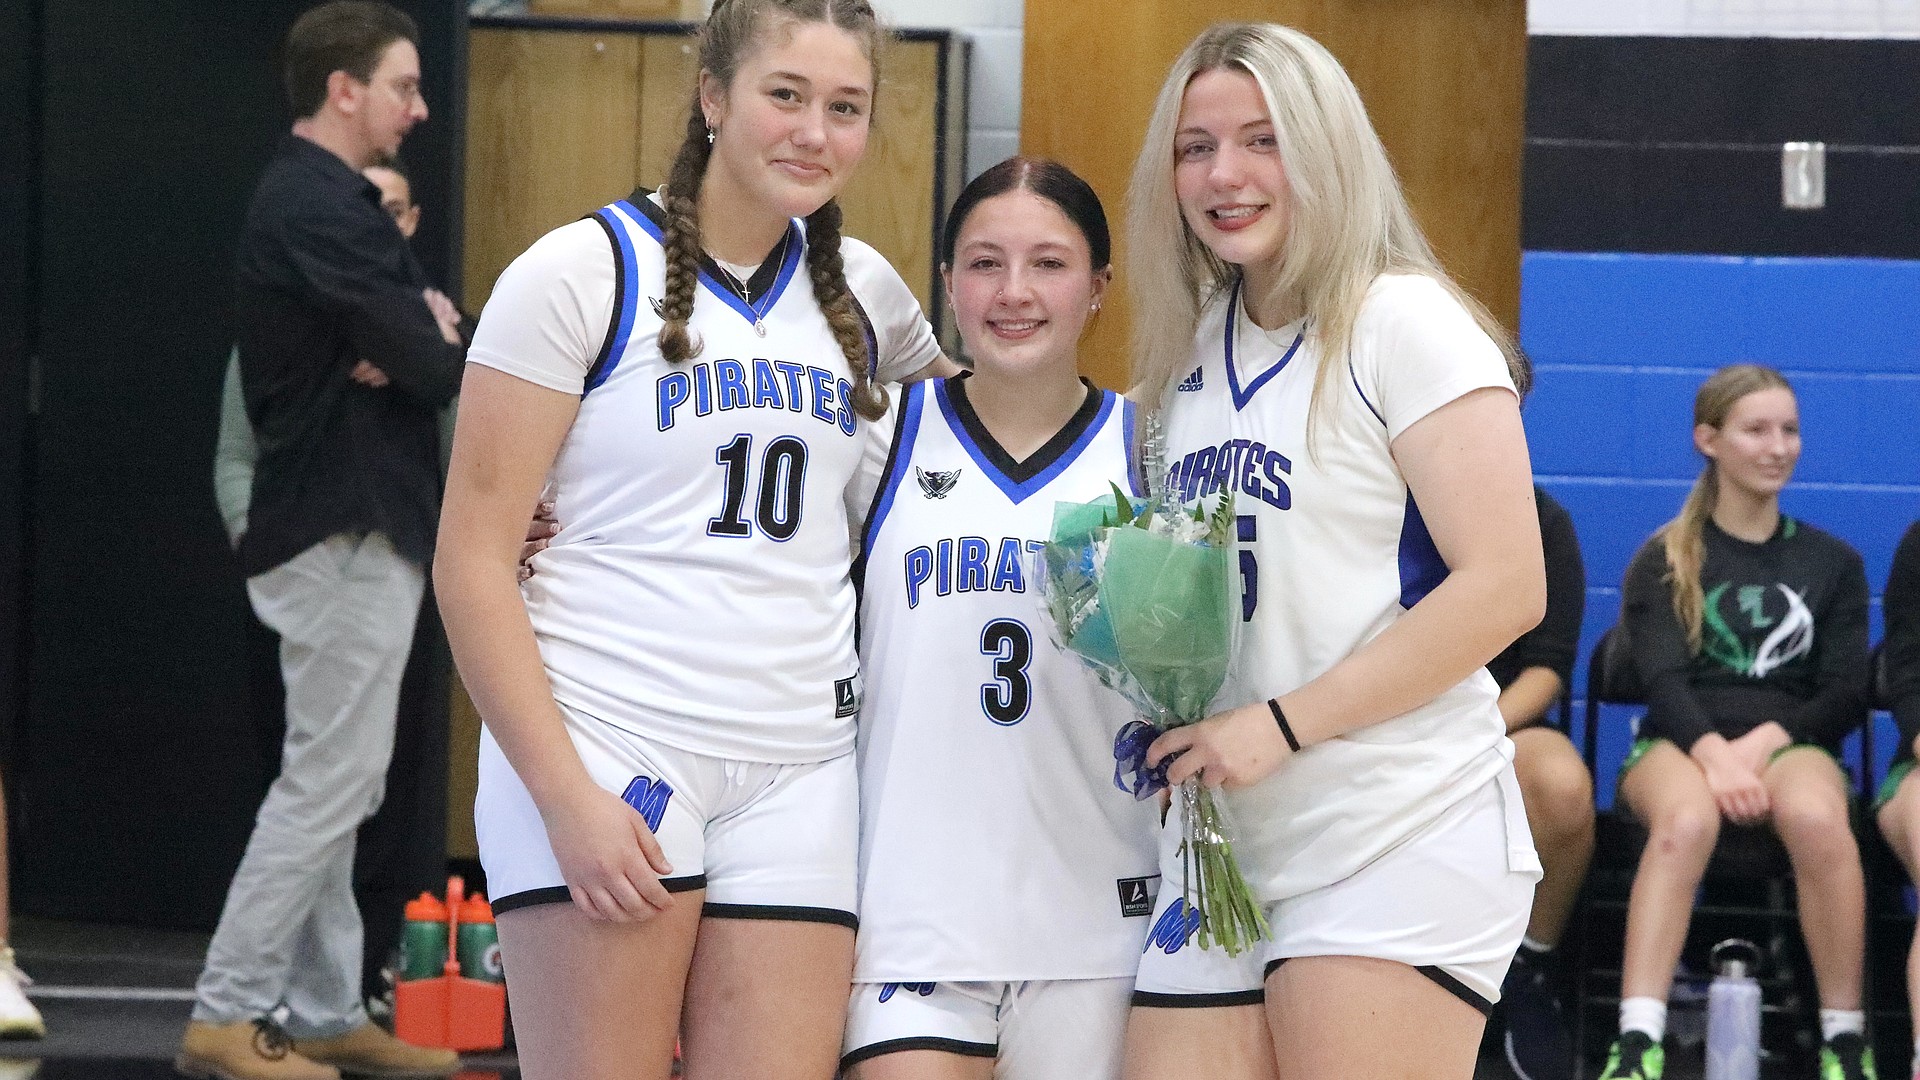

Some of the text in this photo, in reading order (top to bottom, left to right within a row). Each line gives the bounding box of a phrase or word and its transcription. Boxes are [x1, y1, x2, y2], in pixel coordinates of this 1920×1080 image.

[656, 358, 857, 436] PIRATES
[706, 433, 808, 542] 10
[905, 536, 1049, 609] PIRAT
[980, 617, 1033, 727] 3
